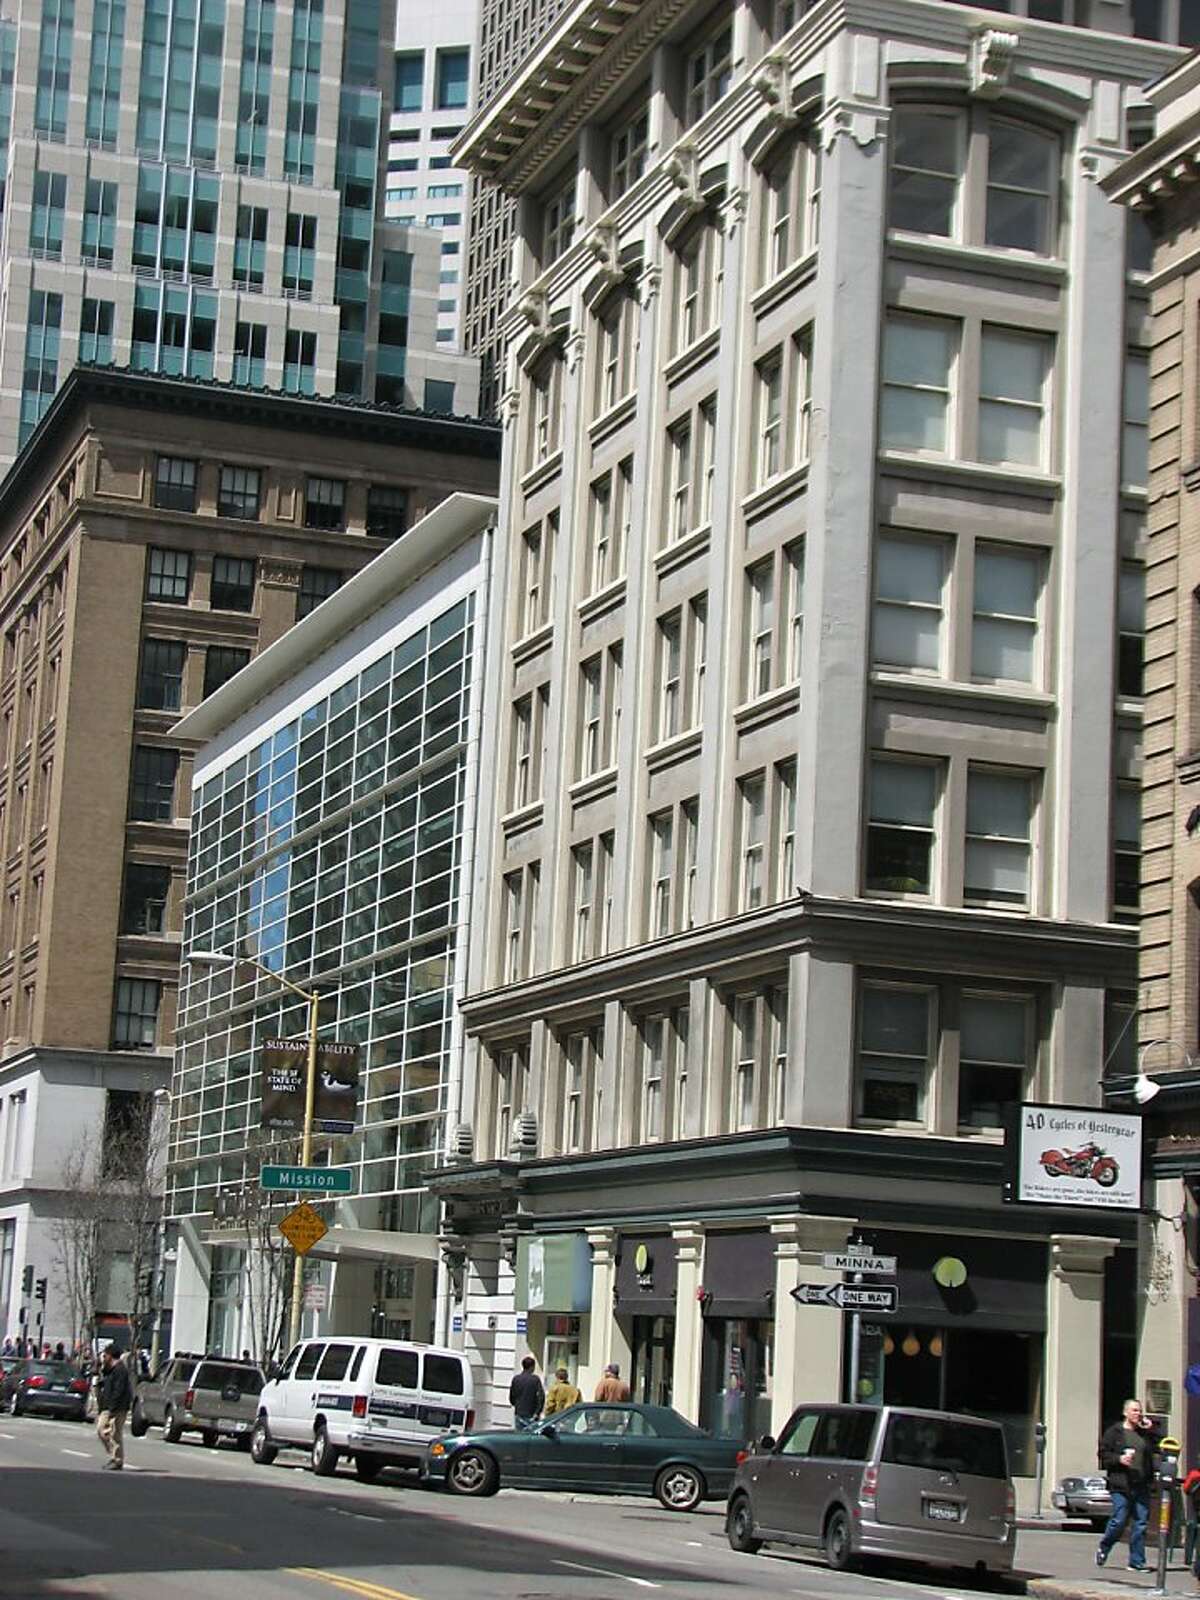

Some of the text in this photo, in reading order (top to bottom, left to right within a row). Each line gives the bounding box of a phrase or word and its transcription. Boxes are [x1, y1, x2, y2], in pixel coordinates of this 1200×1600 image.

[266, 1040, 307, 1051] SUSTAIN
[1049, 1118, 1076, 1131] Cycles
[1078, 1119, 1087, 1129] of
[279, 1172, 335, 1186] Mission
[836, 1257, 884, 1270] MINNA
[843, 1291, 889, 1304] ONE WAY
